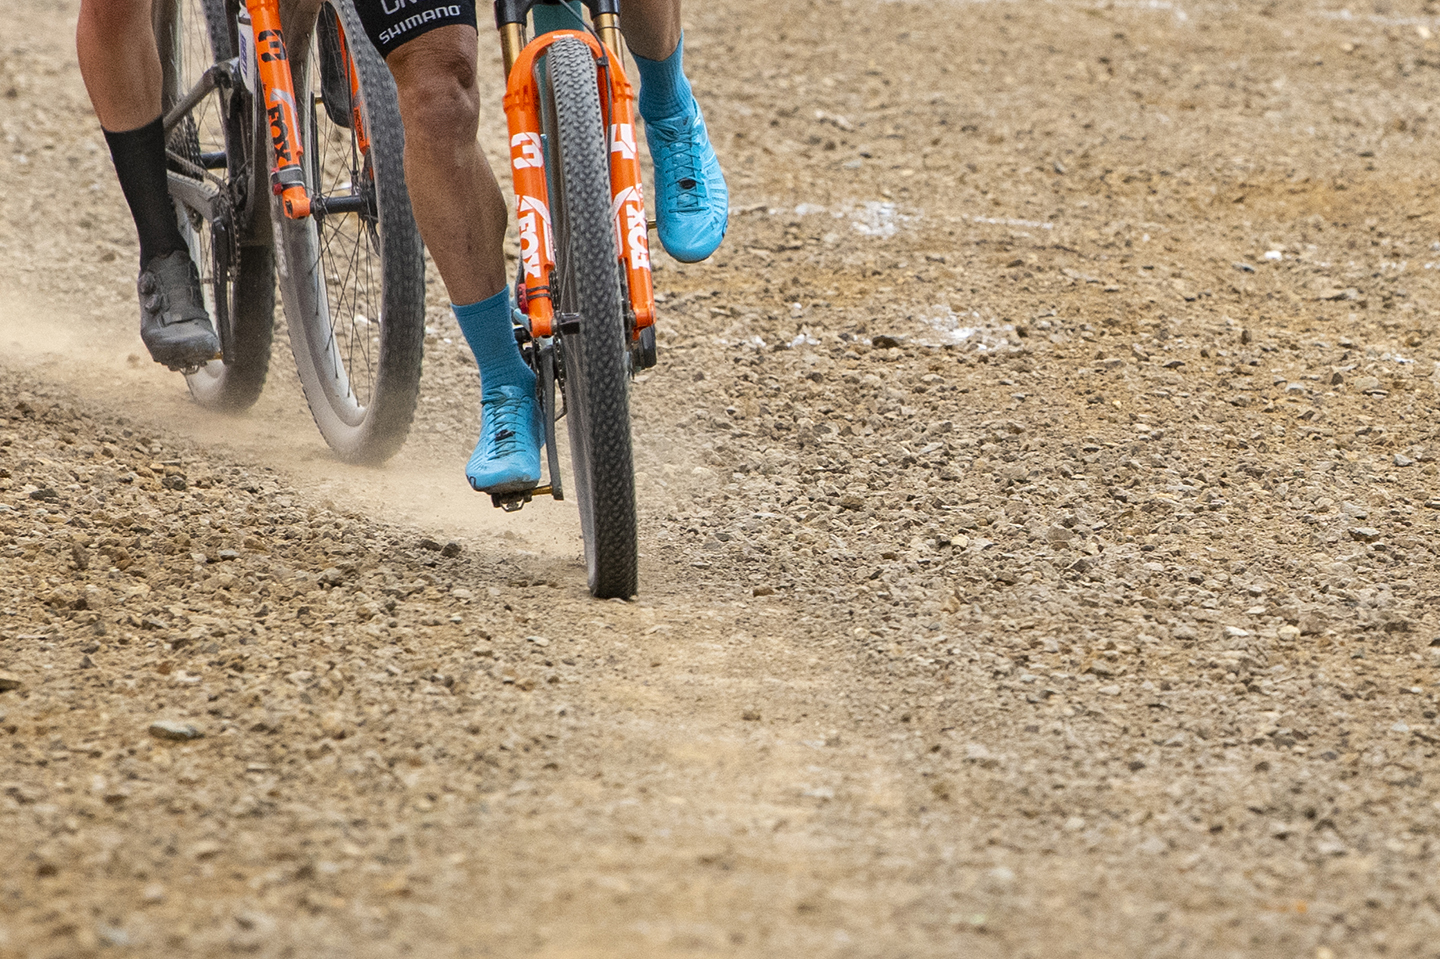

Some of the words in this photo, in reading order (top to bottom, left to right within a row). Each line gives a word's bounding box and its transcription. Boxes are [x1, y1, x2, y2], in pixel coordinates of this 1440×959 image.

[379, 4, 461, 45] SHIMANO
[267, 103, 292, 162] FOX
[518, 211, 542, 279] FOX
[625, 204, 651, 271] FOX
